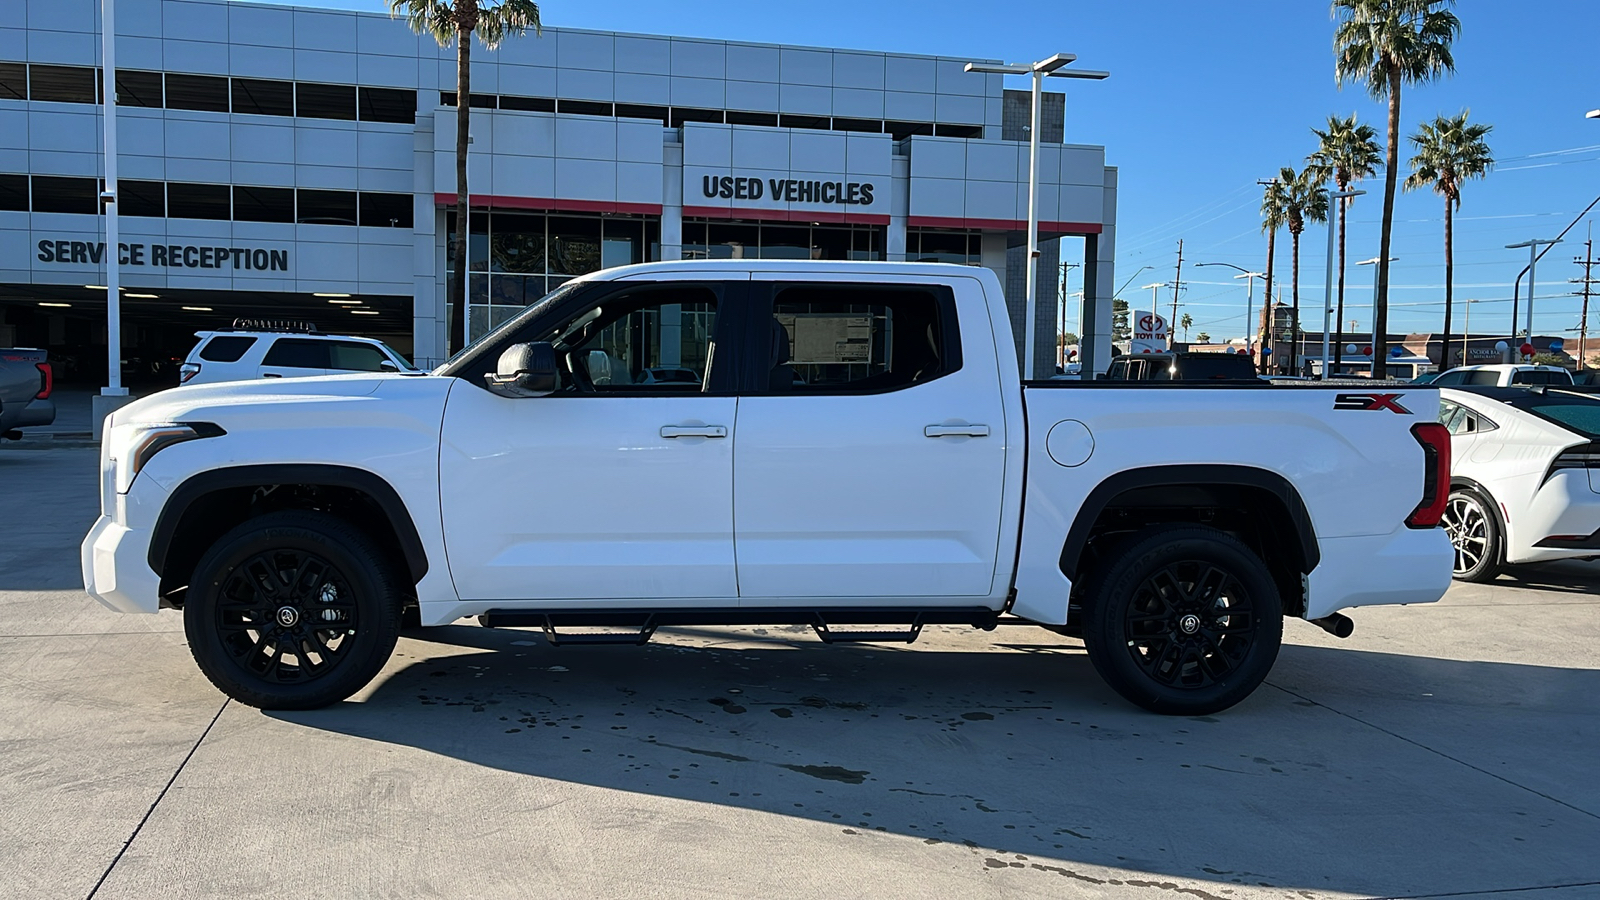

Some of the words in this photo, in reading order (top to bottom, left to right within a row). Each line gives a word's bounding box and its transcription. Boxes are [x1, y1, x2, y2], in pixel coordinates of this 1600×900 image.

[703, 175, 763, 200] USED
[769, 179, 874, 205] VEHICLES
[151, 245, 288, 271] RECEPTION
